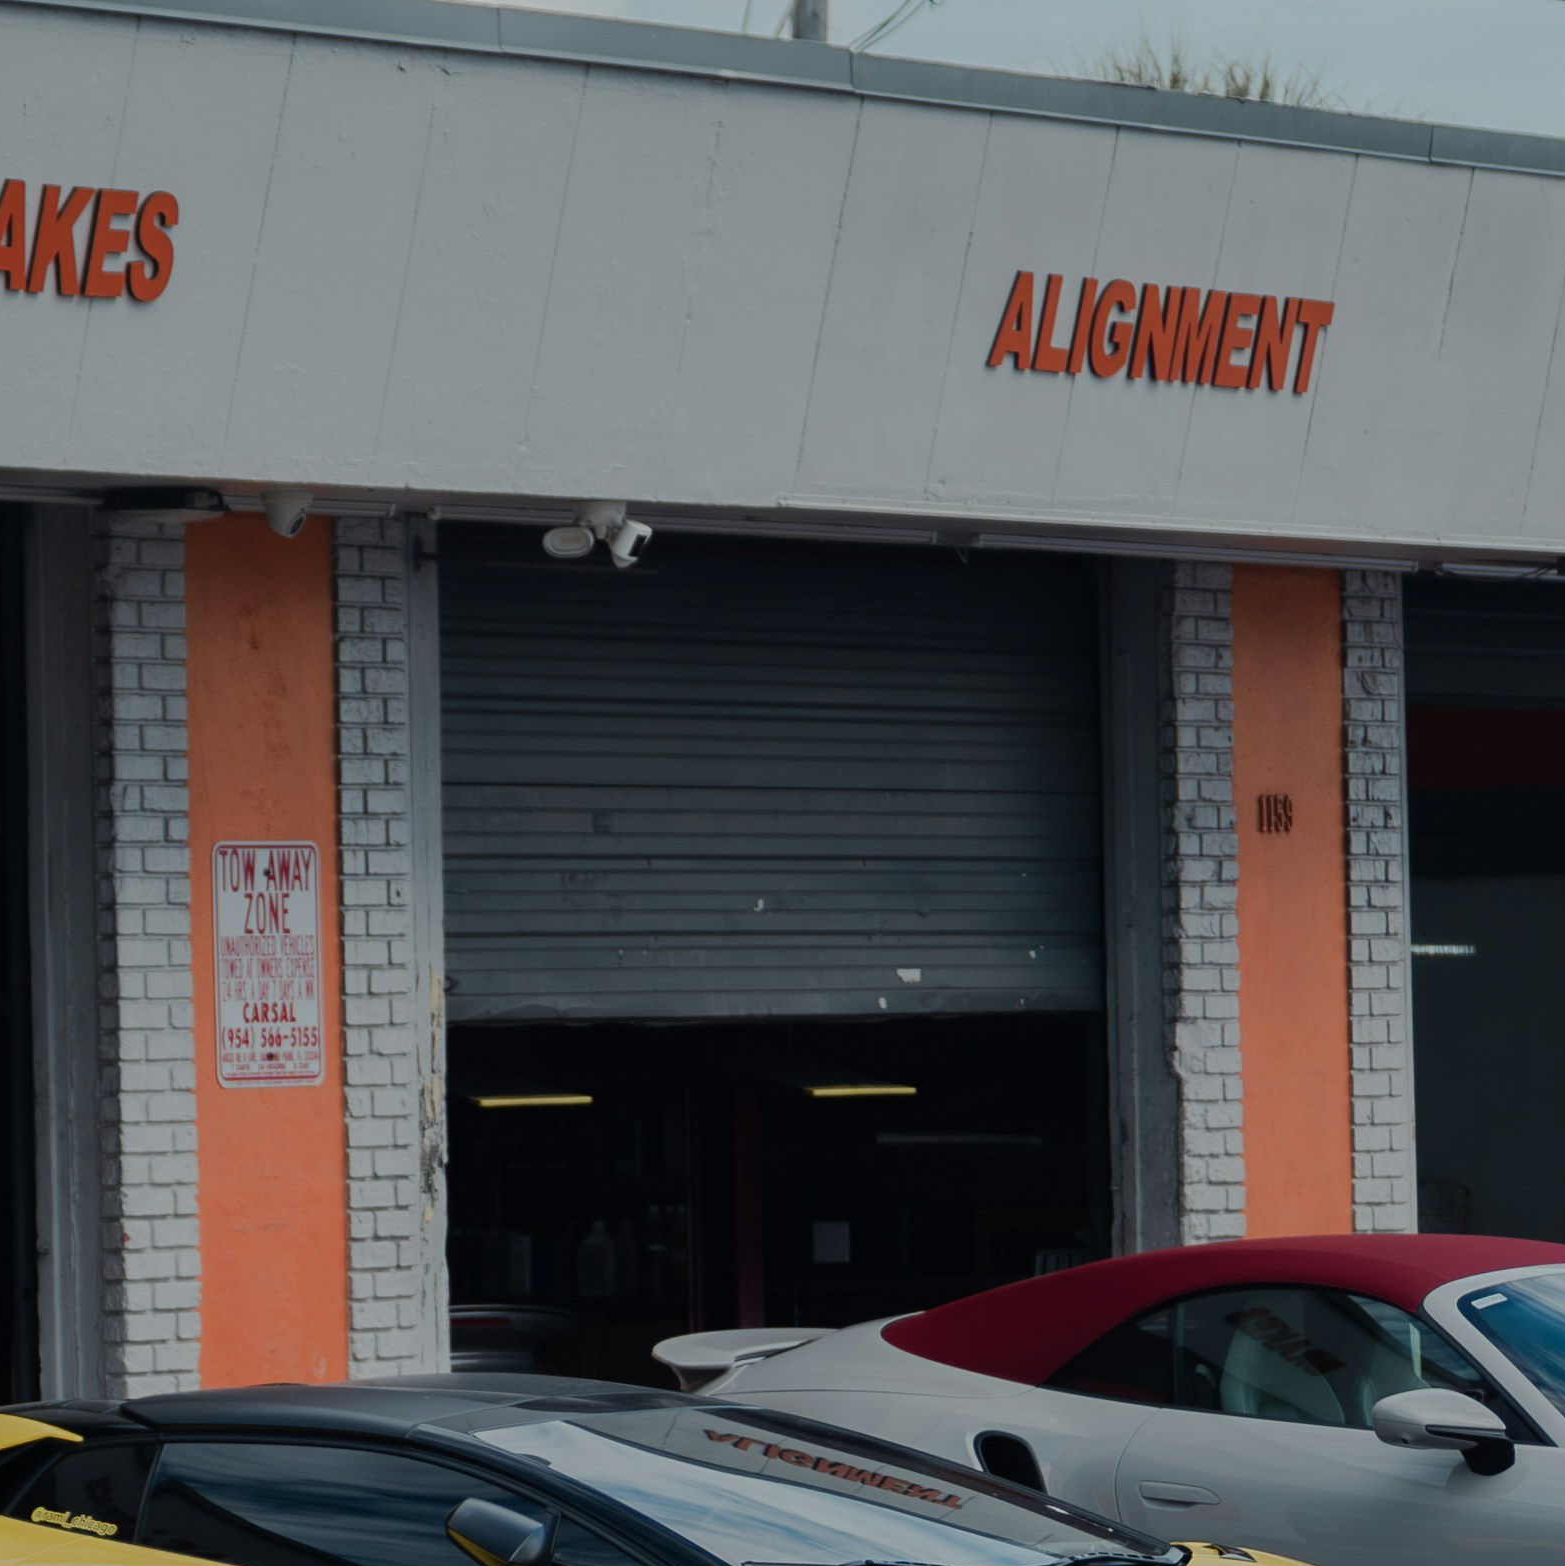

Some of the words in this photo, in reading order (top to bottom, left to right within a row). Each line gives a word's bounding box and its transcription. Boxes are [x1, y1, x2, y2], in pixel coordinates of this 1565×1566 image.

[985, 270, 1335, 394] ALIGNMENT
[219, 848, 256, 892] TOW
[265, 849, 312, 892] AWAY
[244, 891, 290, 934] ZONE
[220, 934, 276, 957] UNAUTHORIZED
[280, 934, 314, 956] VEHICLES
[221, 957, 243, 979] TOWED
[257, 957, 283, 979] OWNERS
[286, 956, 315, 979] EXPENSE
[242, 1001, 296, 1023] CARSAL
[222, 1026, 255, 1050] (954)
[261, 1026, 318, 1048] 566-5155
